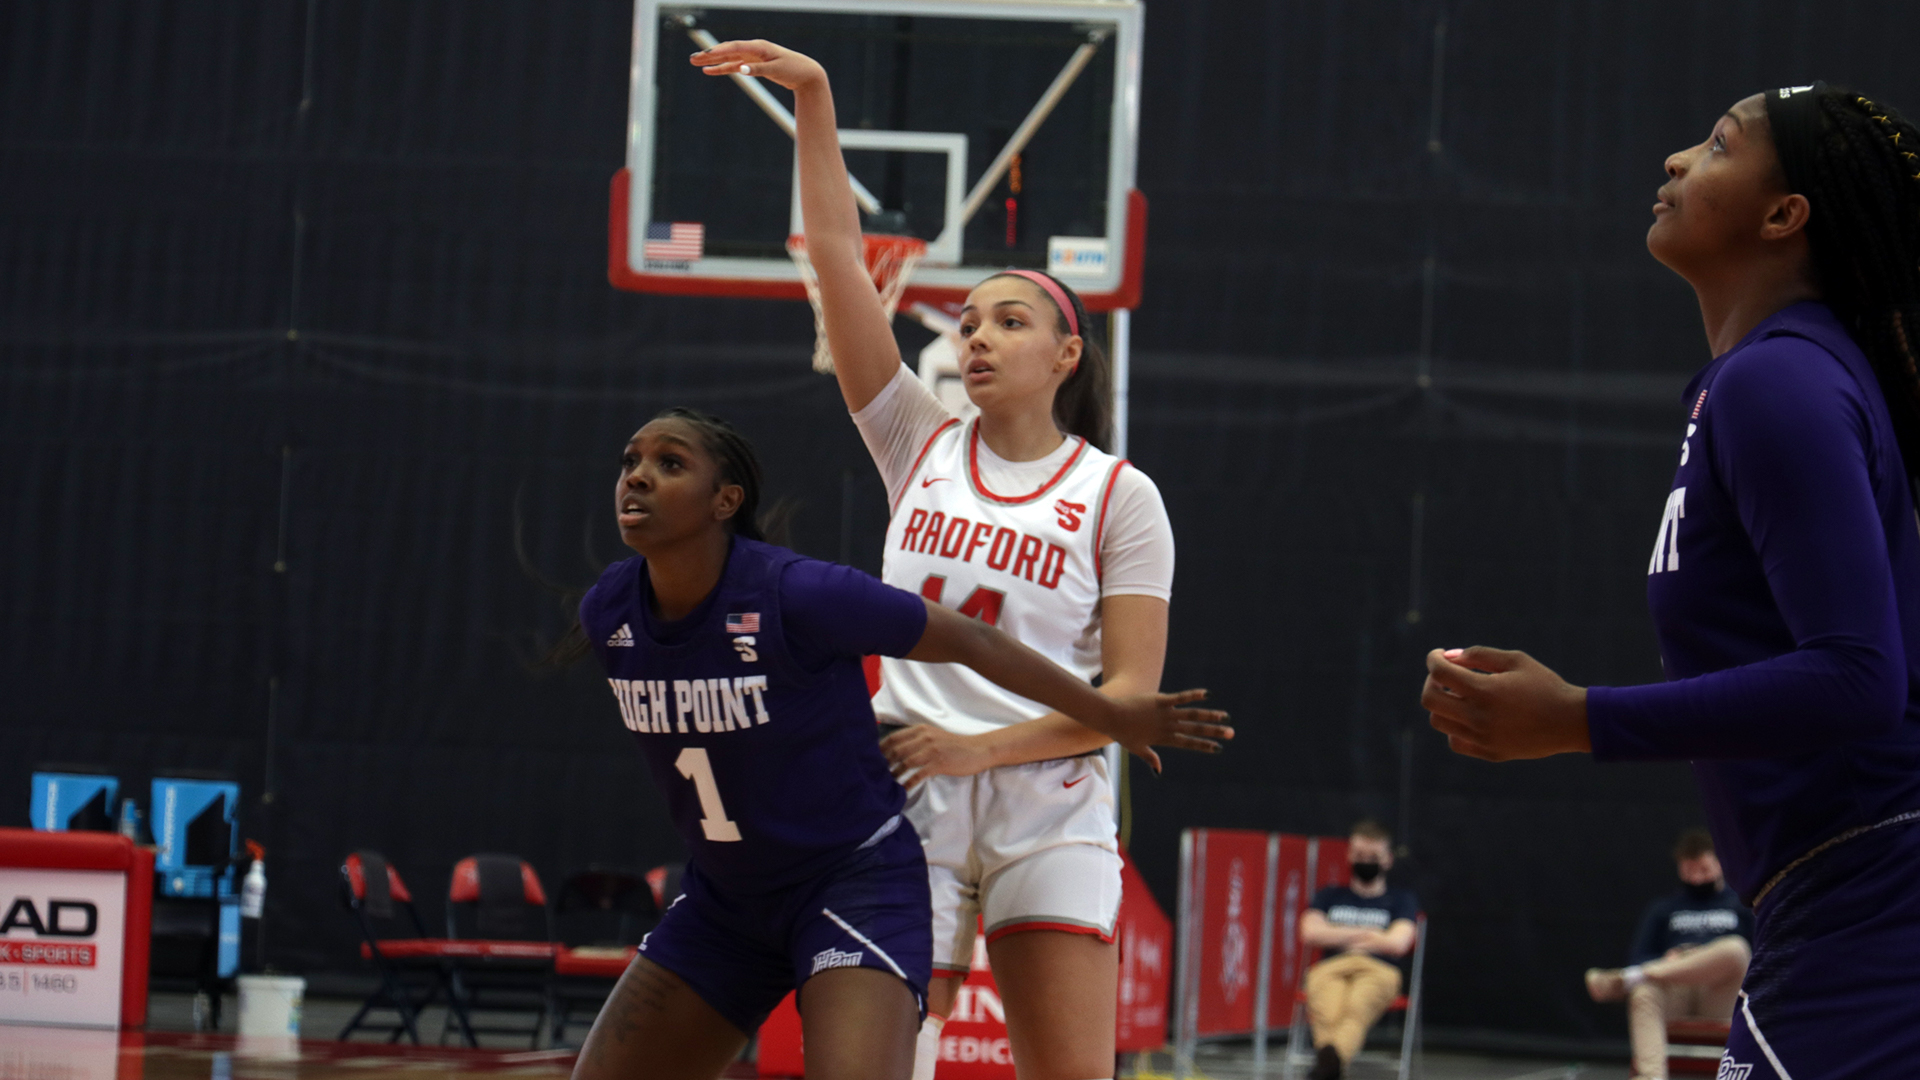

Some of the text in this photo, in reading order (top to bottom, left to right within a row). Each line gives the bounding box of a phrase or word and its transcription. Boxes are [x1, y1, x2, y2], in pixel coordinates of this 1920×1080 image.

[900, 508, 1067, 590] RADFORD
[607, 639, 635, 647] adidas
[607, 675, 770, 733] HIGH POINT
[674, 747, 743, 842] 1
[22, 945, 92, 966] SPORTS
[938, 1035, 1015, 1065] EDIC
